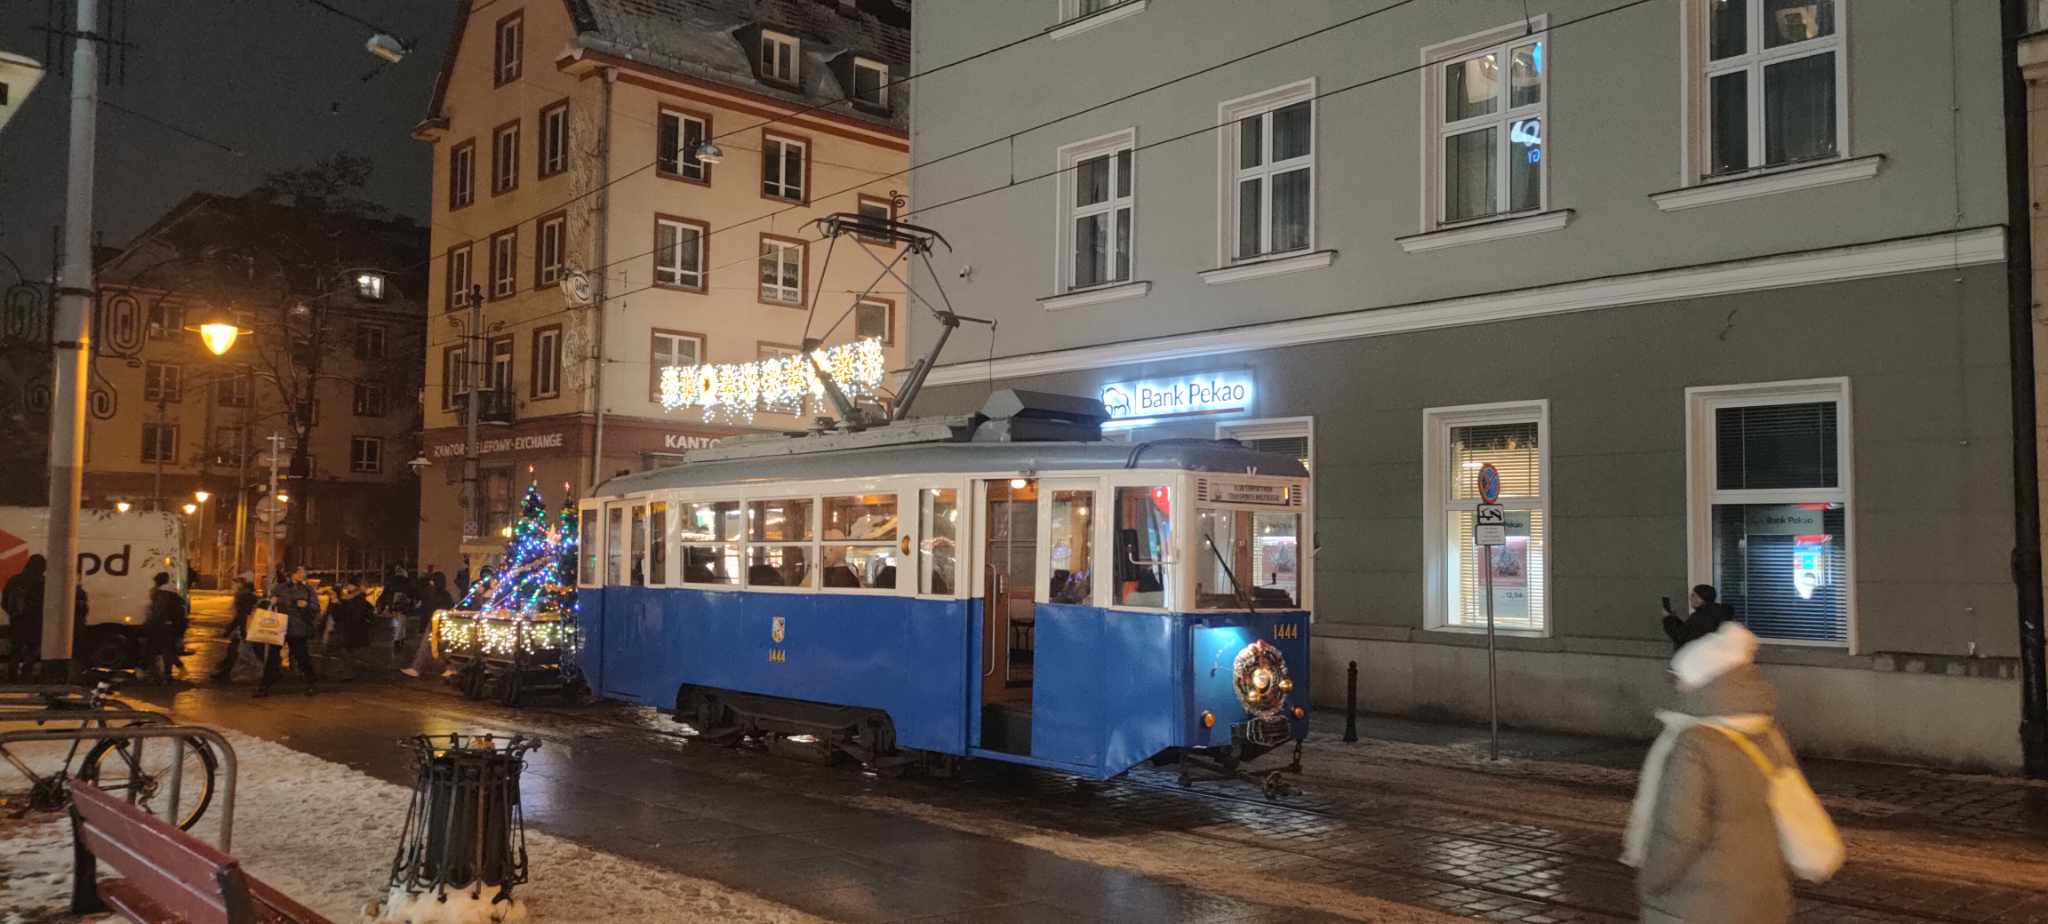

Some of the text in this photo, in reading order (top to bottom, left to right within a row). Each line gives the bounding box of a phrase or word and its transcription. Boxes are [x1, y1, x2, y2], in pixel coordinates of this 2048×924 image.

[1142, 381, 1245, 409] Bank Pekao
[515, 433, 563, 450] EXCHANGE
[77, 544, 131, 577] pd
[1273, 624, 1297, 640] 1444
[768, 648, 786, 663] 1444
